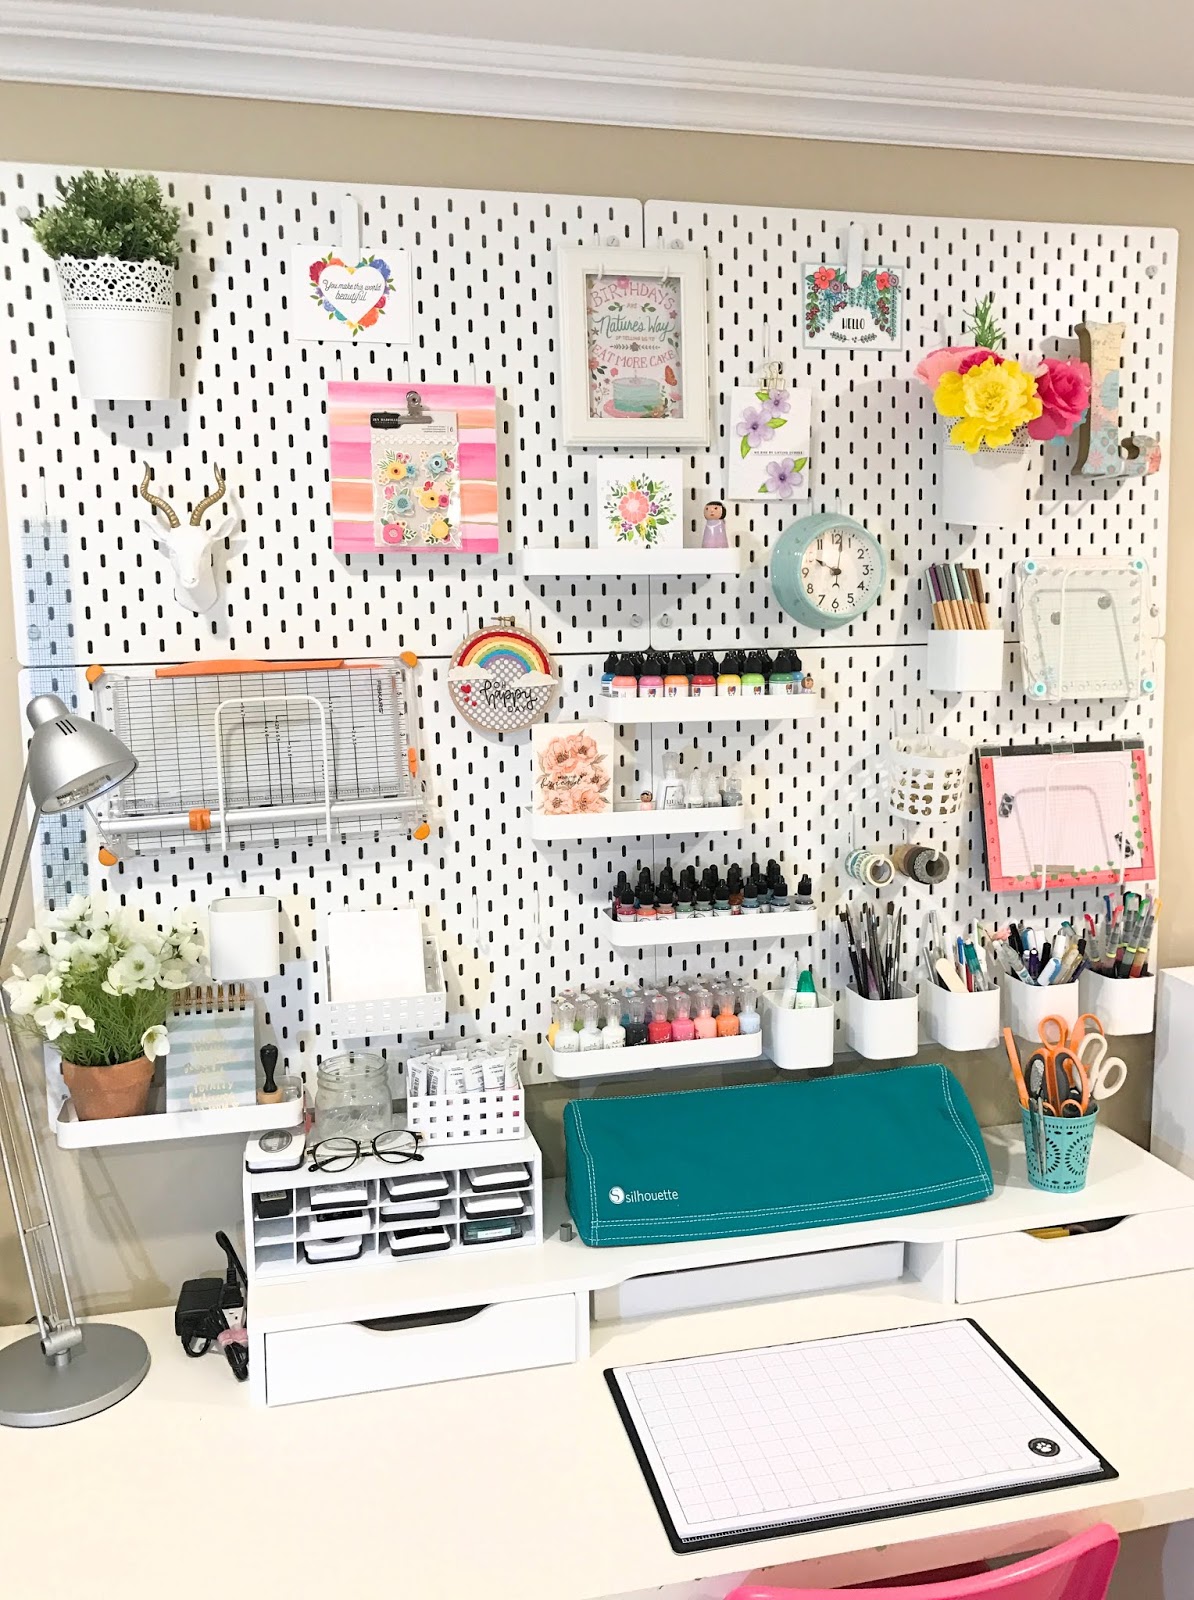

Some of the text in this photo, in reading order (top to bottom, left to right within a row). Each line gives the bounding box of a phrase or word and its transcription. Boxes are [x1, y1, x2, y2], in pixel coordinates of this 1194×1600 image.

[322, 279, 337, 291] You
[338, 282, 354, 290] make
[354, 282, 364, 290] this
[335, 290, 367, 304] beautiful
[591, 282, 675, 310] BIRTHDAYS
[646, 315, 675, 342] Way
[841, 317, 866, 330] HELLO
[592, 344, 676, 369] EAT MORE CAKE
[817, 539, 823, 550] 11
[831, 533, 842, 545] 12
[848, 537, 851, 548] 1
[857, 548, 864, 559] 2
[801, 567, 810, 578] 9
[862, 564, 870, 576] 3
[806, 583, 814, 594] 8
[857, 581, 865, 590] 4
[818, 594, 826, 606] 7
[831, 598, 839, 609] 6
[847, 593, 854, 604] 5
[493, 681, 506, 689] OH
[479, 680, 538, 710] happy
[507, 705, 527, 713] DAY
[625, 1189, 679, 1203] silhouette
